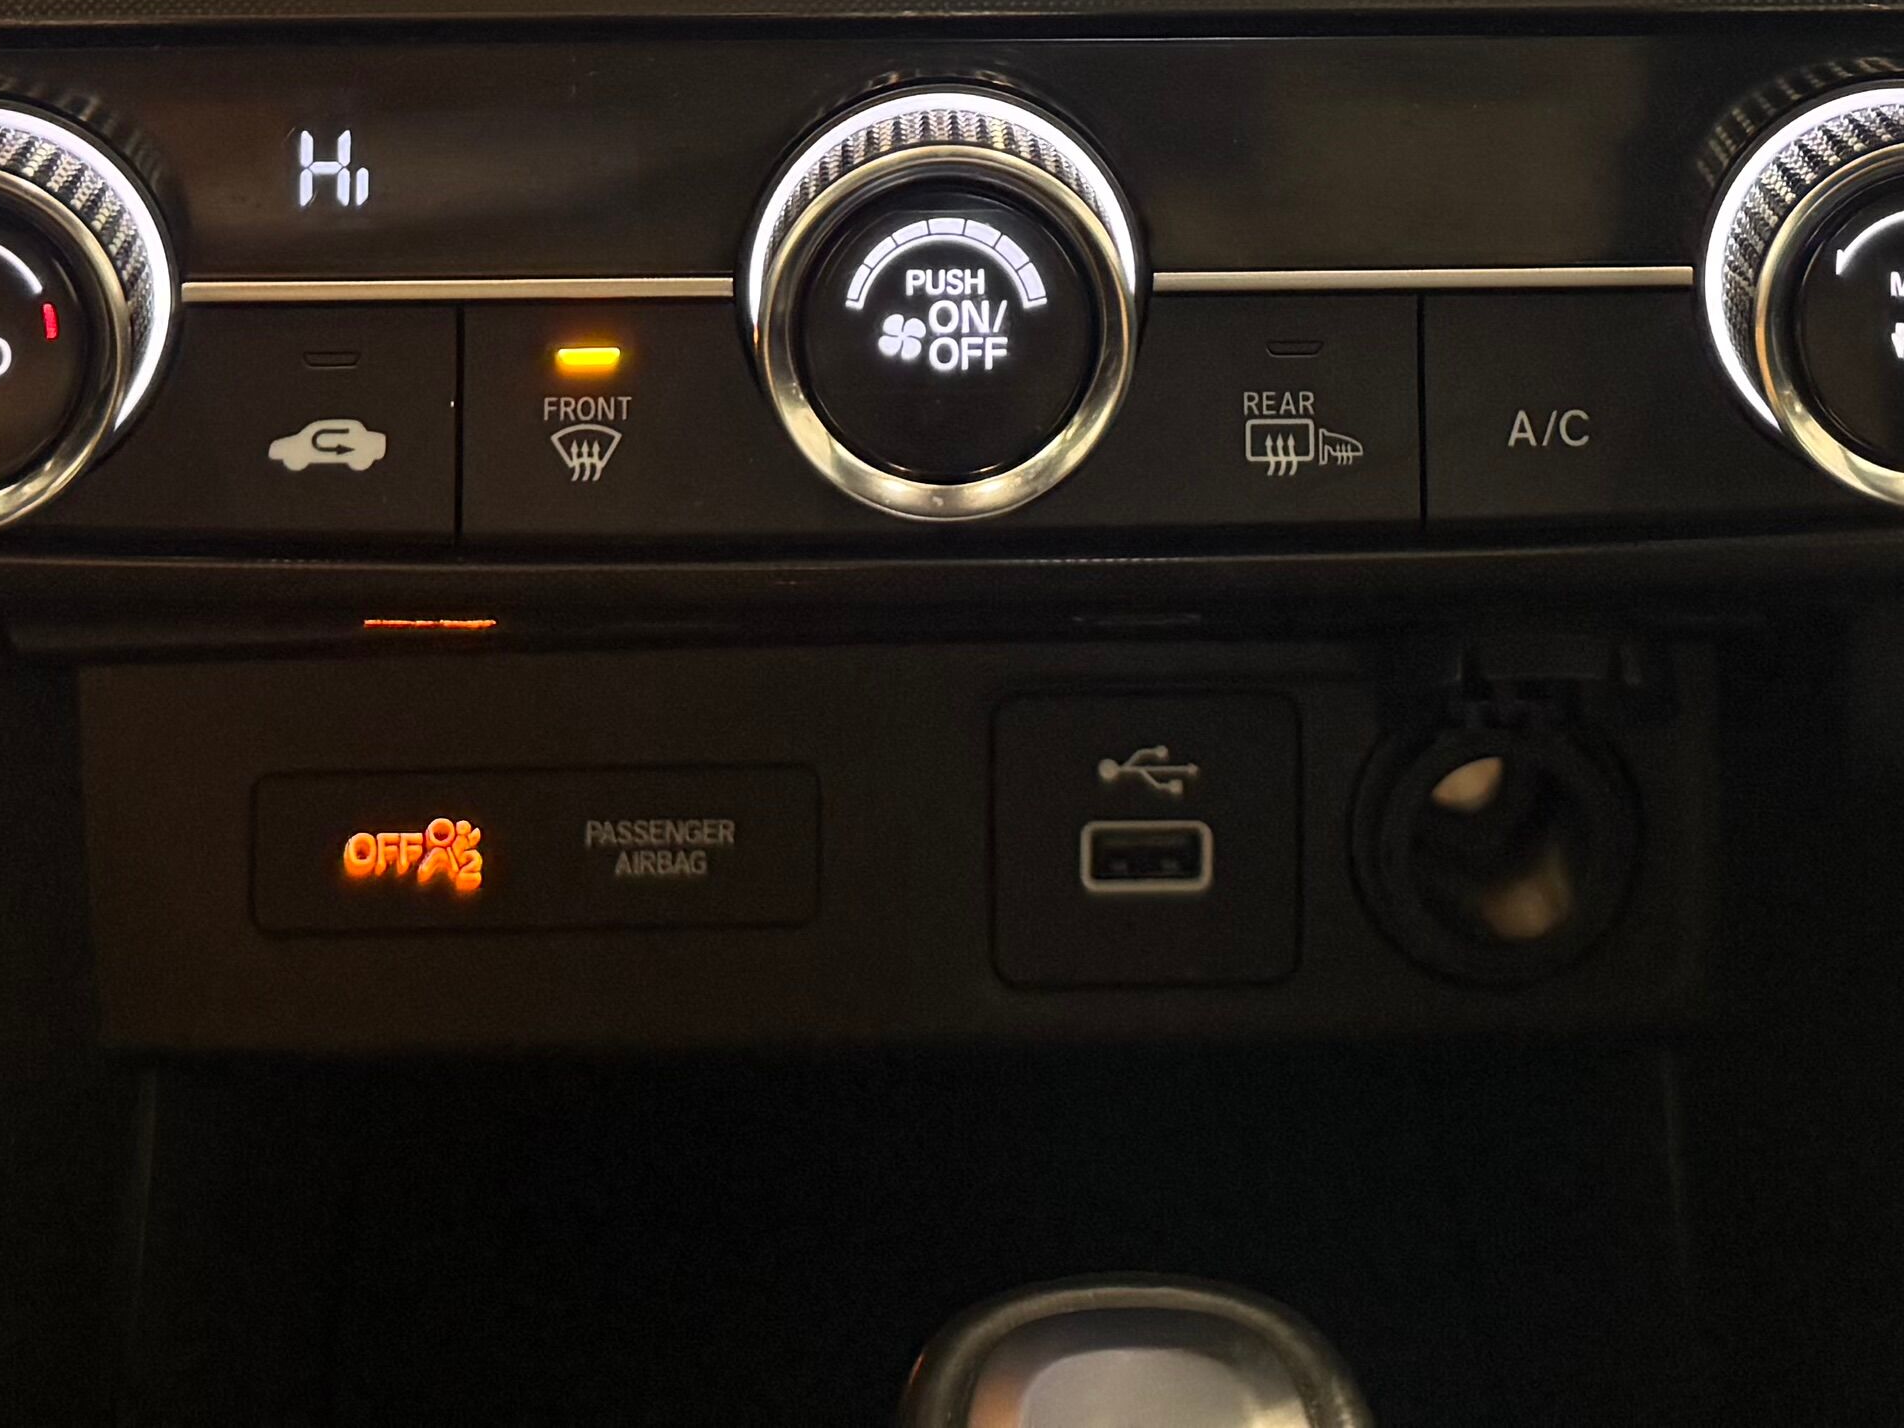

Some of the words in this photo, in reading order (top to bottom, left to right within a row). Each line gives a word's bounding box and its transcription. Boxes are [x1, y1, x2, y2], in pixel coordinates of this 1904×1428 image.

[905, 268, 985, 296] PUSH
[928, 300, 1008, 333] ON/
[928, 337, 1008, 370] OFF
[543, 397, 632, 421] FRONT
[1243, 391, 1315, 414] REAR
[1508, 410, 1590, 448] A/C
[584, 819, 735, 847] PASSENGER
[344, 832, 423, 878] OFF
[615, 850, 708, 877] AIRBAG
